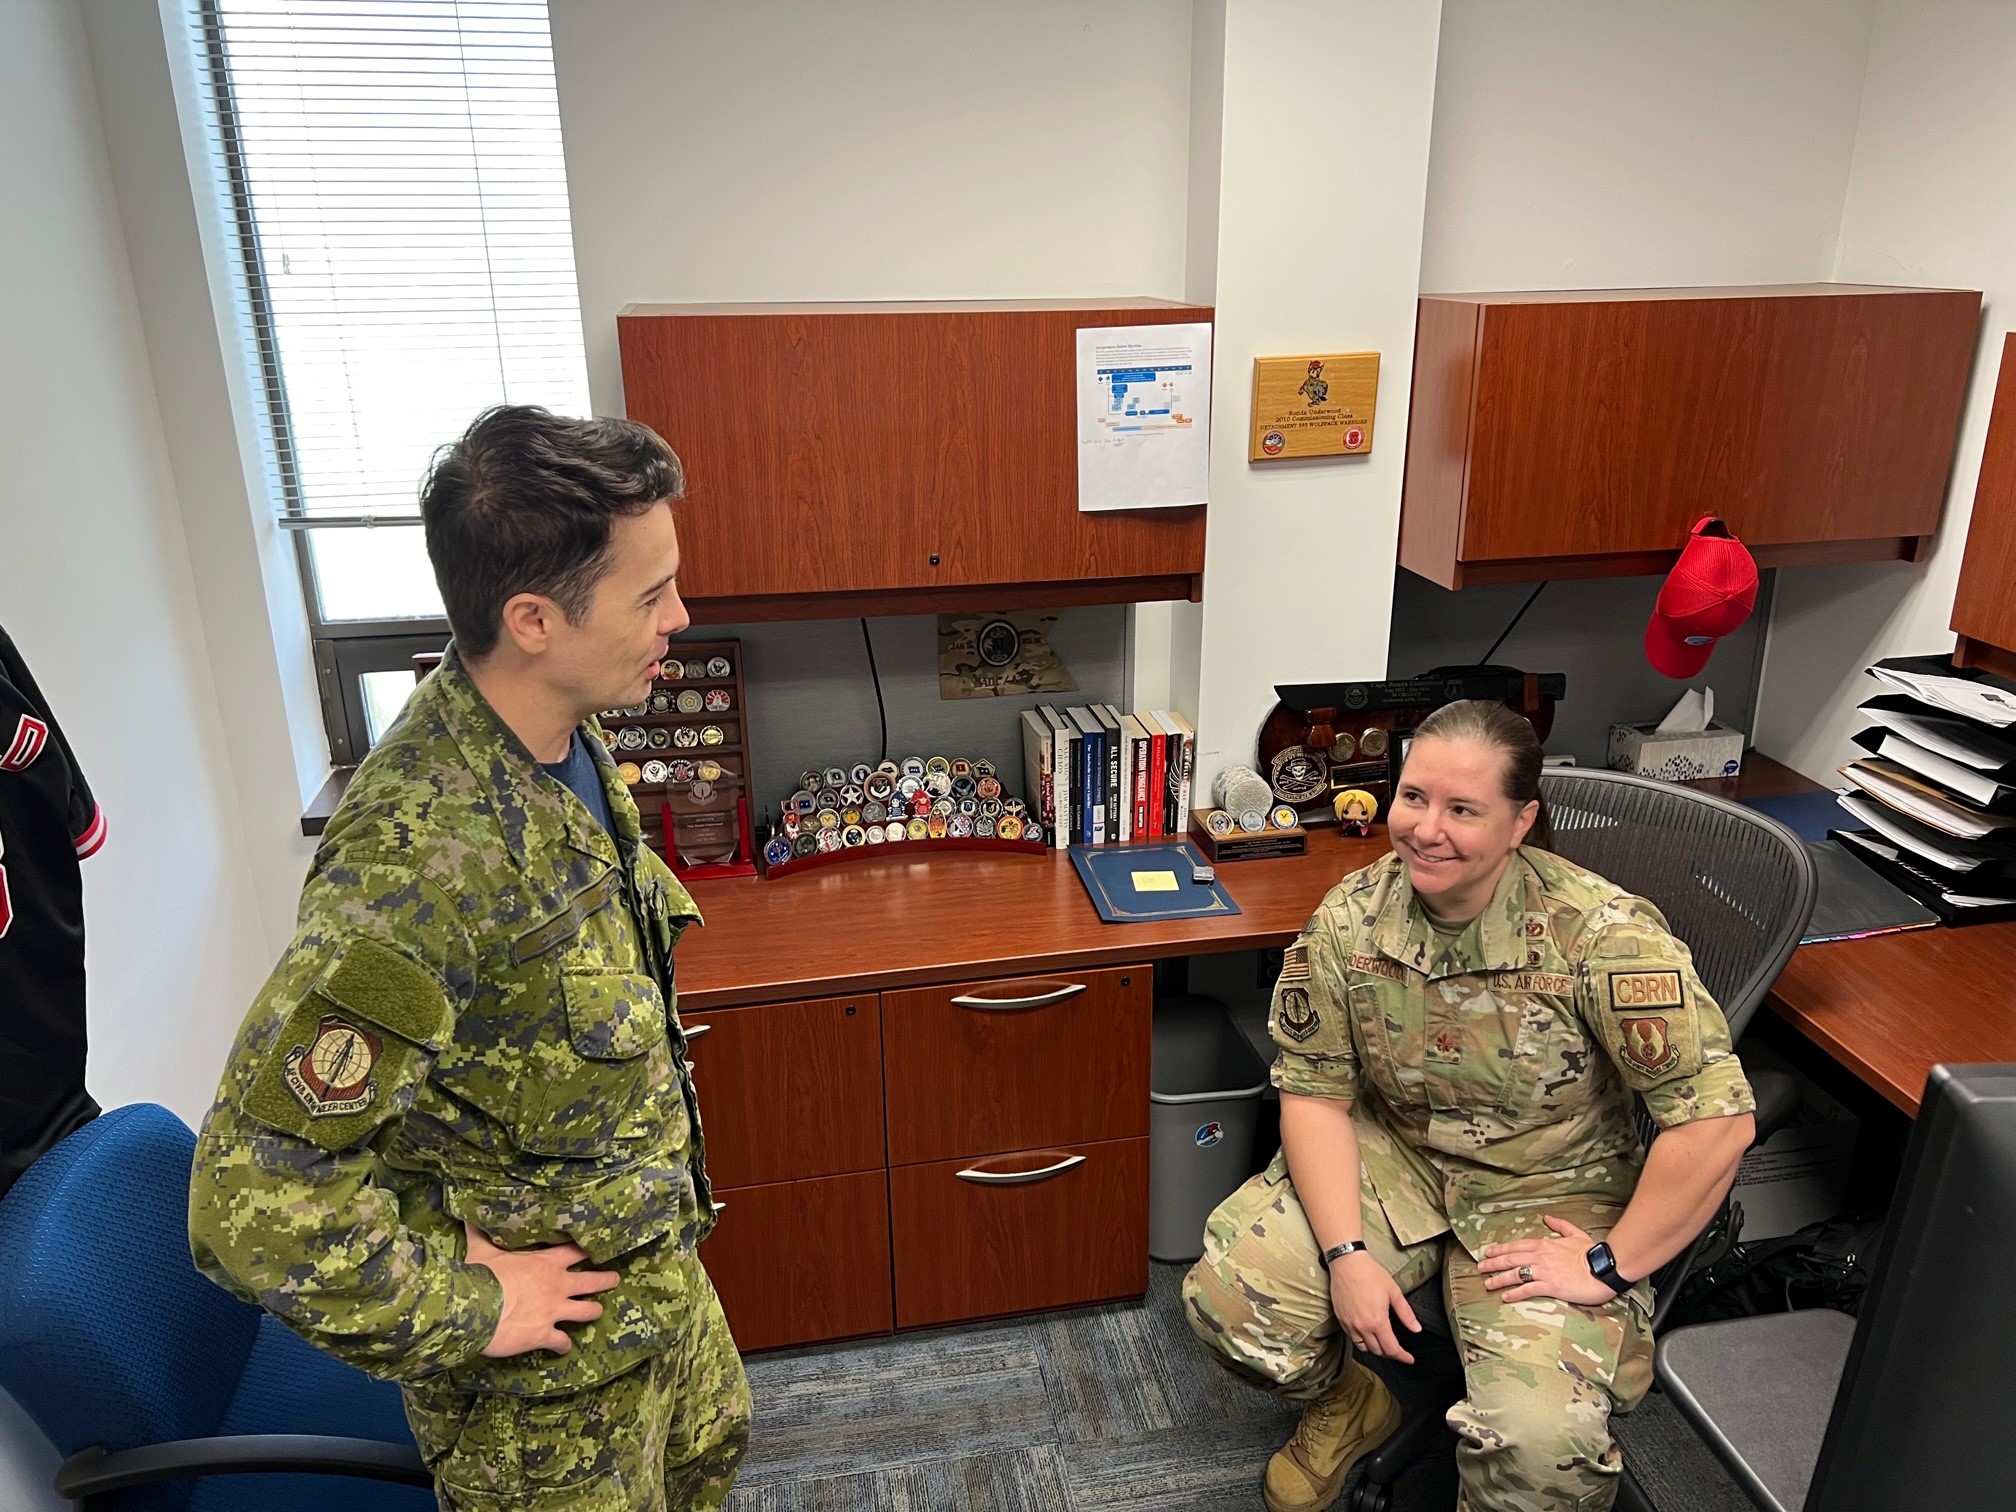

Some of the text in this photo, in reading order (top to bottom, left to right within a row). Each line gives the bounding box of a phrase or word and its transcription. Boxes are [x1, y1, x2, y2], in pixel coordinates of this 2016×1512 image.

[950, 642, 965, 650] JAN
[1137, 740, 1147, 802] OPERATION VENGEANCE
[1493, 974, 1567, 992] U.S. AIR FORCE
[1616, 975, 1678, 1004] CBRN
[286, 1067, 368, 1114] AF CIVIL ENGINEER CENTER
